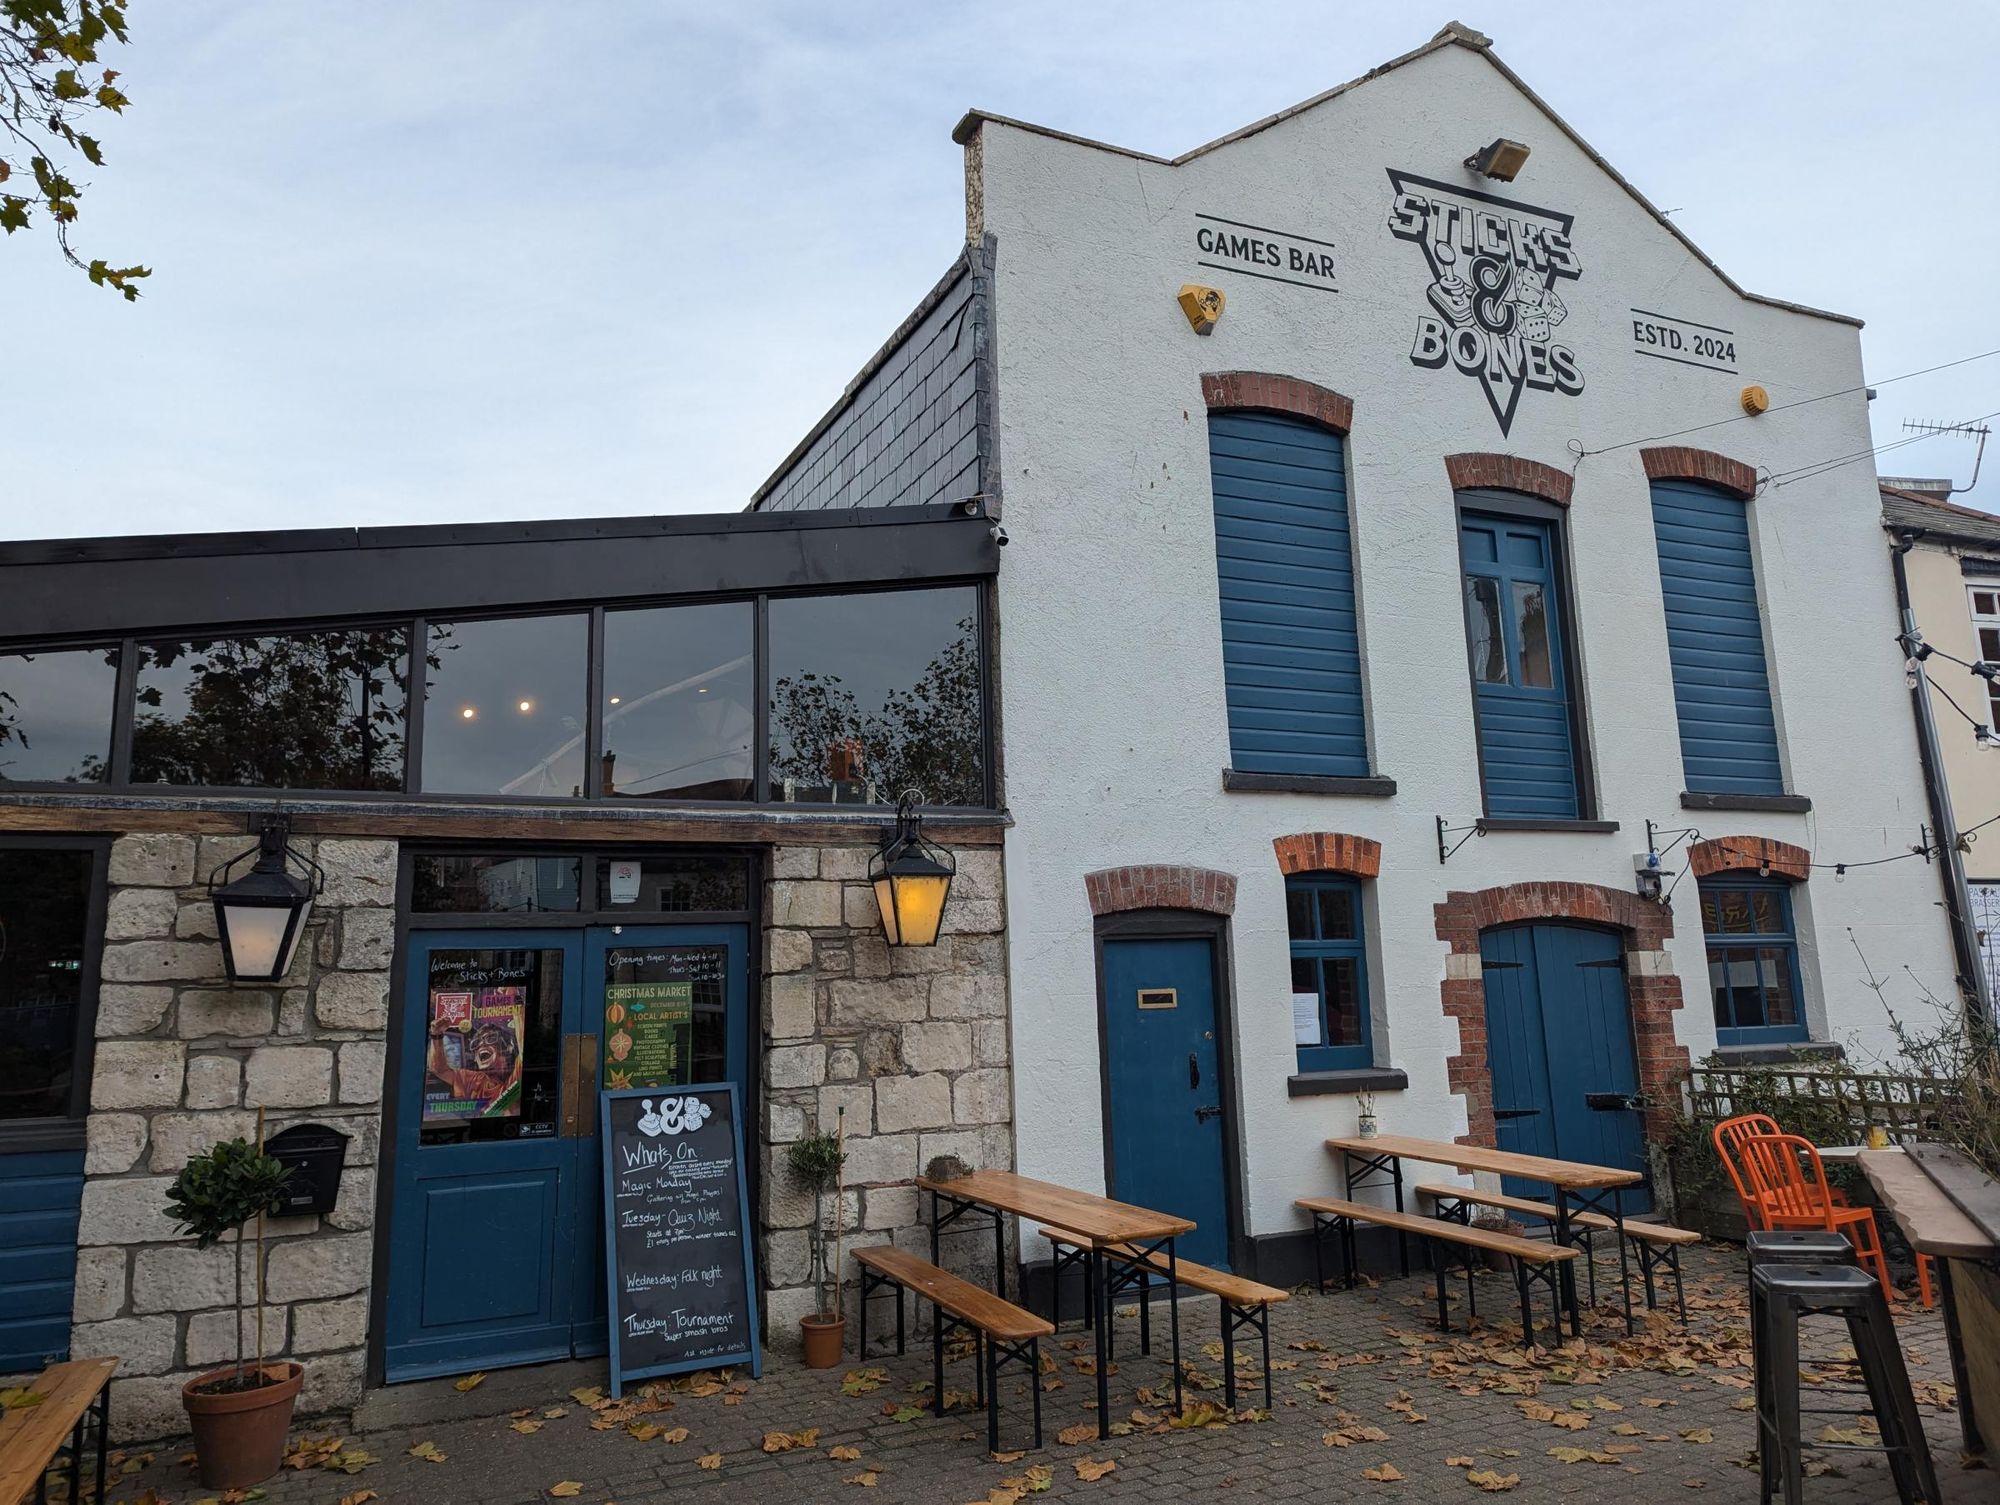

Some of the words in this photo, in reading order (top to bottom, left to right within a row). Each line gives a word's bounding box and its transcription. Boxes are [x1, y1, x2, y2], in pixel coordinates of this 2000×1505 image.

[1388, 190, 1582, 280] STICKS
[1196, 227, 1281, 269] GAMES
[1289, 247, 1336, 280] BAR
[1633, 320, 1688, 354] ESTD.
[1694, 334, 1737, 364] 2024
[1410, 315, 1586, 397] BONES
[430, 958, 466, 973] Welcome
[470, 958, 478, 968] to
[609, 952, 644, 970] Opening
[485, 996, 512, 1006] GAMES
[607, 987, 655, 1000] CHRISTMAS
[657, 986, 692, 998] MARKET
[473, 1004, 523, 1018] TOURNAMENT
[634, 1013, 657, 1021] LOCAL
[430, 1101, 478, 1112] THURSDAY
[622, 1178, 652, 1196] Magic
[656, 1176, 692, 1194] Monday
[668, 1208, 696, 1231] Quiz
[698, 1206, 722, 1226] Night
[646, 1230, 662, 1238] Starts
[681, 1270, 698, 1284] Folk
[701, 1264, 722, 1288] night
[671, 1308, 734, 1329] Tournament
[684, 1328, 708, 1338] smash
[710, 1326, 728, 1334] bros
